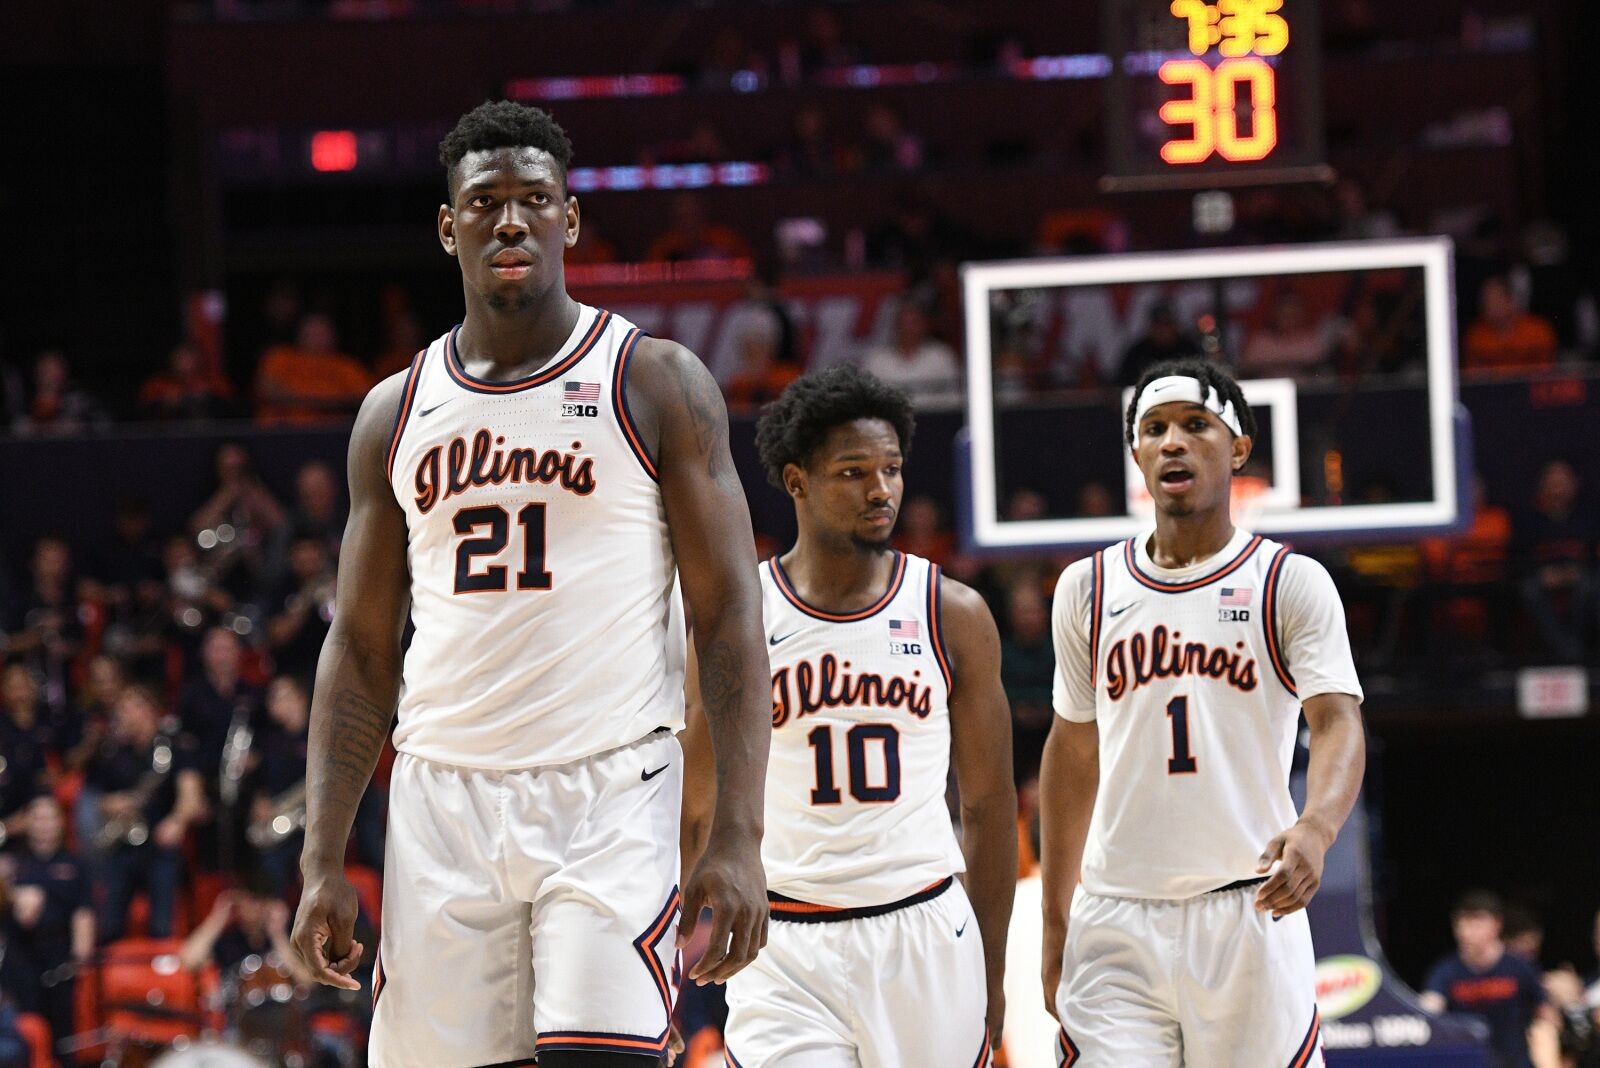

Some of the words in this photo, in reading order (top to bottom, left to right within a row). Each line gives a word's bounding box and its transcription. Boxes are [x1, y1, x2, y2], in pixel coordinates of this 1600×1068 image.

[1158, 56, 1277, 165] 30
[414, 428, 597, 515] Illinois
[452, 502, 553, 596] 21
[771, 653, 932, 730] Illinois
[1106, 624, 1258, 701] Illinois
[807, 722, 902, 807] 10
[1166, 695, 1198, 776] 1
